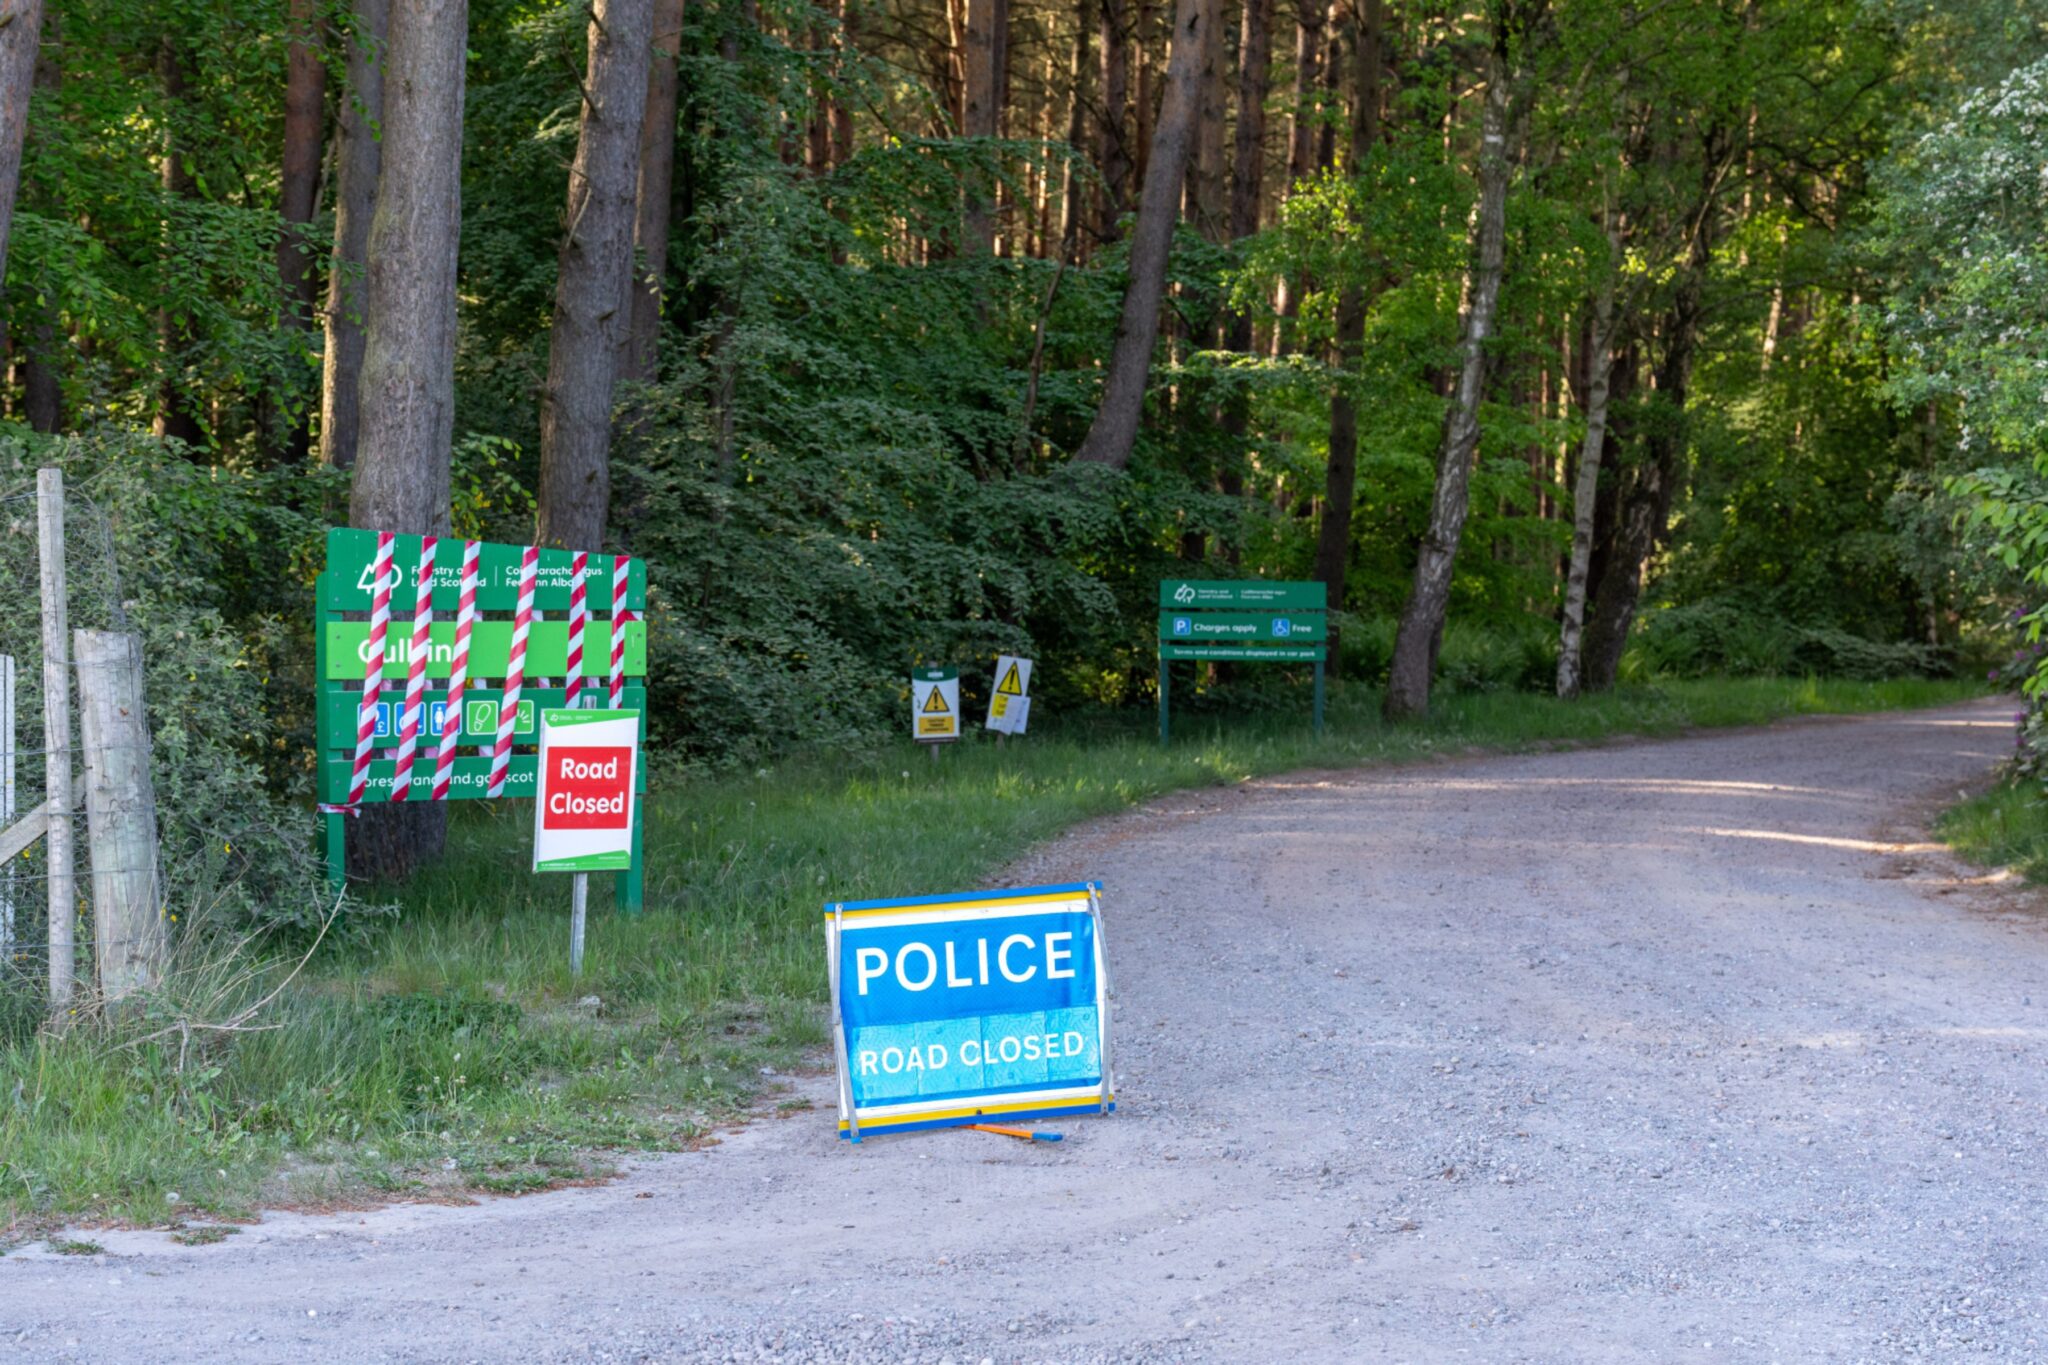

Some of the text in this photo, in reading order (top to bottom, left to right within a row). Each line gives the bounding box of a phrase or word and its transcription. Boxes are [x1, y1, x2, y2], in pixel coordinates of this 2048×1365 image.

[411, 566, 454, 577] Fostry
[411, 578, 437, 587] Ld
[1193, 623, 1257, 633] Charges apply
[1292, 624, 1312, 632] Free
[561, 756, 618, 779] Road
[550, 791, 624, 814] Closed
[856, 931, 1075, 995] POLICE
[860, 1031, 1084, 1076] ROAD CLOSED
